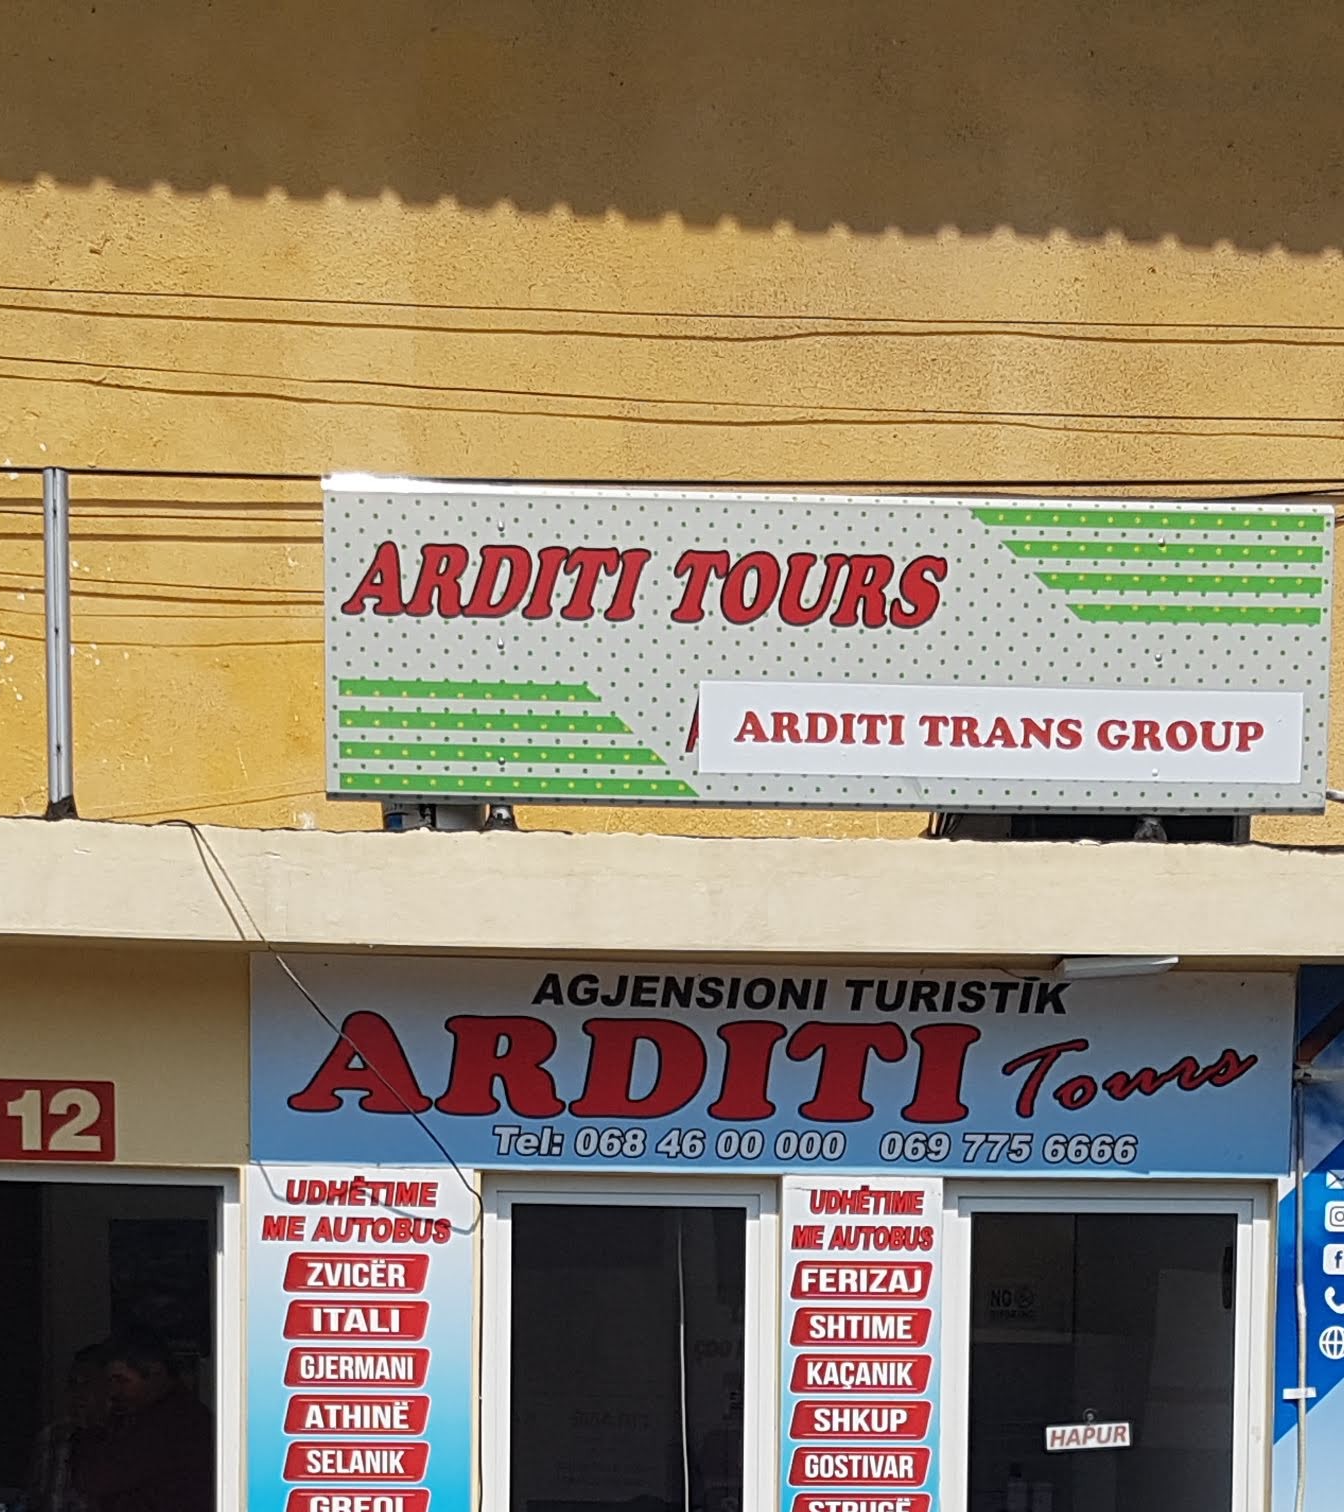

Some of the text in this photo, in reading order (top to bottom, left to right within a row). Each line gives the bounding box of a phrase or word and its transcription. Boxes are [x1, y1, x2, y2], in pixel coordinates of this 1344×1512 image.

[341, 540, 948, 630] ARDITI TOURS
[733, 710, 905, 746] ARDITI
[919, 714, 1083, 750] TRANS
[1096, 718, 1265, 753] GROUP
[532, 972, 1071, 1015] AGJENSIONI TURISTIK
[287, 1009, 1258, 1124] ARDITI Tours
[7, 1087, 102, 1154] 12
[493, 1124, 1139, 1166] Tel: 068 46 00 000 069 775 6666
[286, 1175, 439, 1207] UDHËTIME
[261, 1215, 452, 1244] ME AUTOBUS
[791, 1225, 935, 1251] ME AUTOBUS
[306, 1259, 406, 1288] ZVICËR
[800, 1267, 923, 1293] FERIZAJ
[312, 1307, 401, 1333] ITALI
[809, 1315, 913, 1340] SHTIME
[300, 1355, 414, 1380] GJERMANI
[806, 1361, 913, 1389] KAÇANIK
[305, 1401, 409, 1429] ATHINË
[813, 1408, 908, 1433] SHKUP
[1049, 1425, 1127, 1448] HAPUR
[306, 1449, 405, 1474] SELANIK
[805, 1454, 914, 1479] GOSTIVAR
